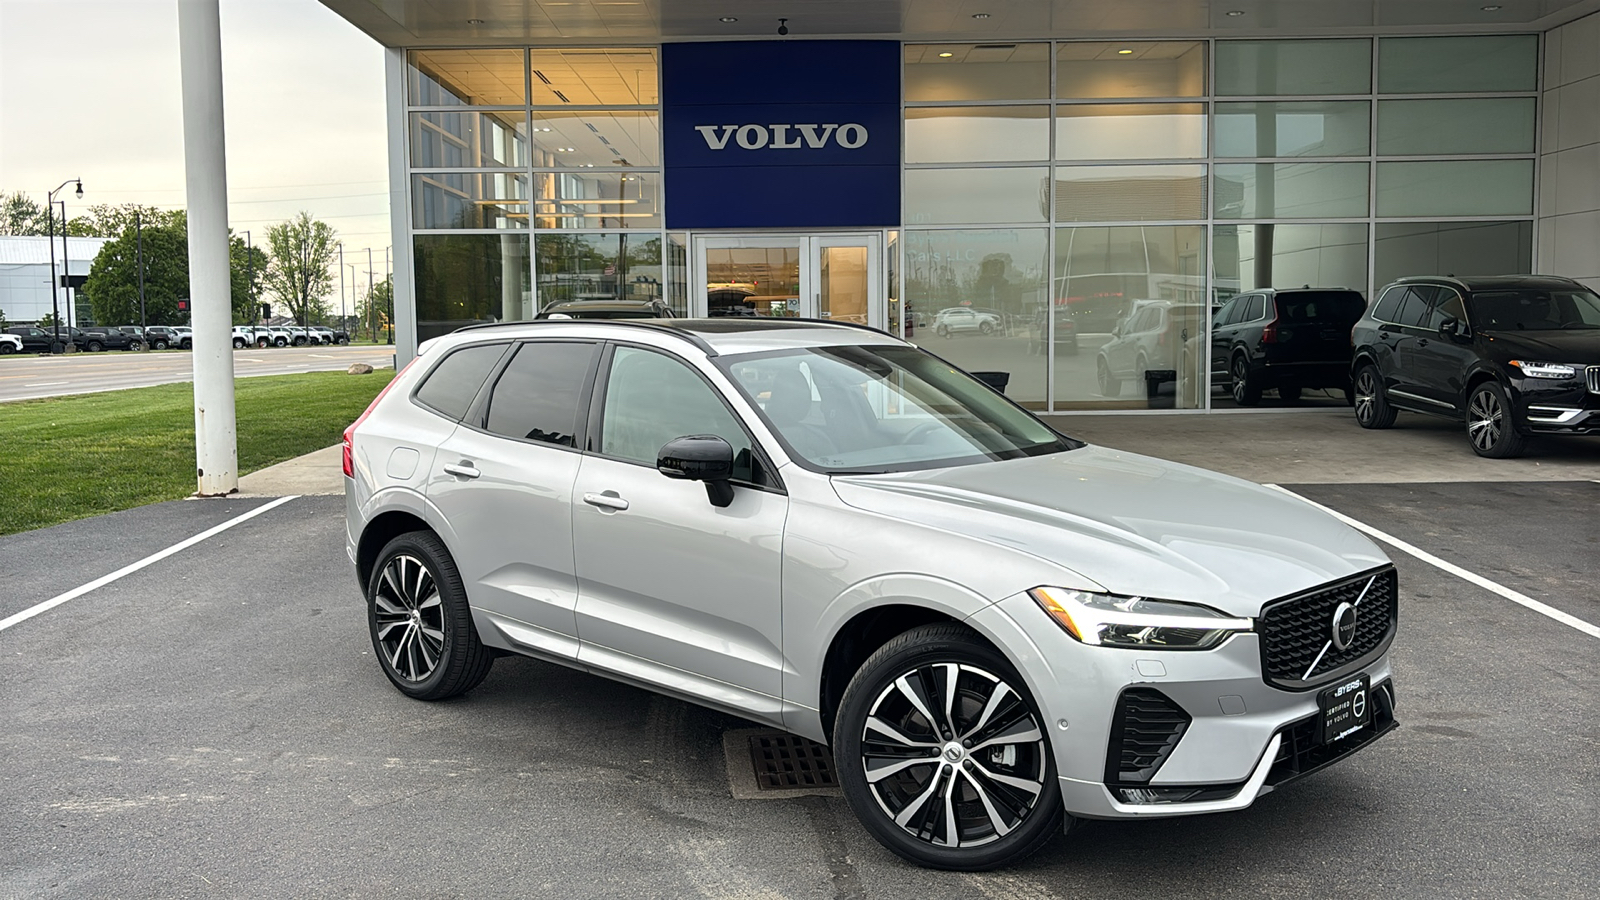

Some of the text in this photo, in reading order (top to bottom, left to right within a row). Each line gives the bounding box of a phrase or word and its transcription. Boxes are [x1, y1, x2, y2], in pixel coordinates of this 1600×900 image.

[695, 123, 868, 150] VOLVO
[947, 248, 975, 261] LLC
[1337, 679, 1360, 697] BYERS
[1327, 711, 1349, 727] BY VOLVO
